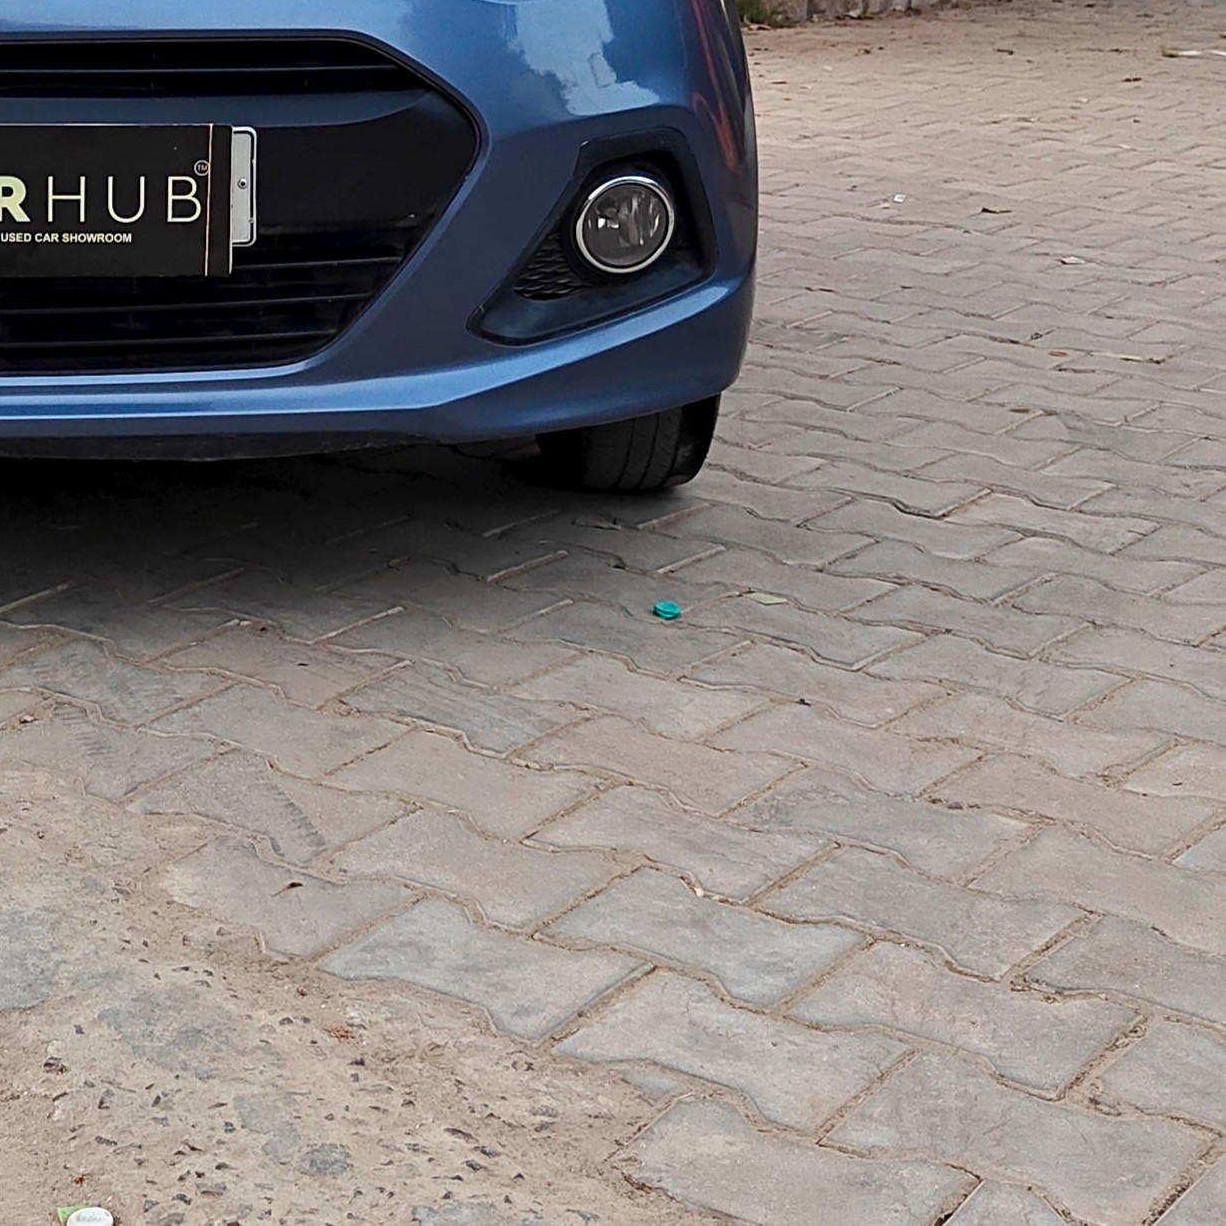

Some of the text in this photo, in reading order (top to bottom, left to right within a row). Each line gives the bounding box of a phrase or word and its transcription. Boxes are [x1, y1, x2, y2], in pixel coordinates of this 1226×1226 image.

[1, 232, 31, 243] USED
[35, 232, 59, 243] CAR
[62, 232, 132, 243] SHOWROOM
